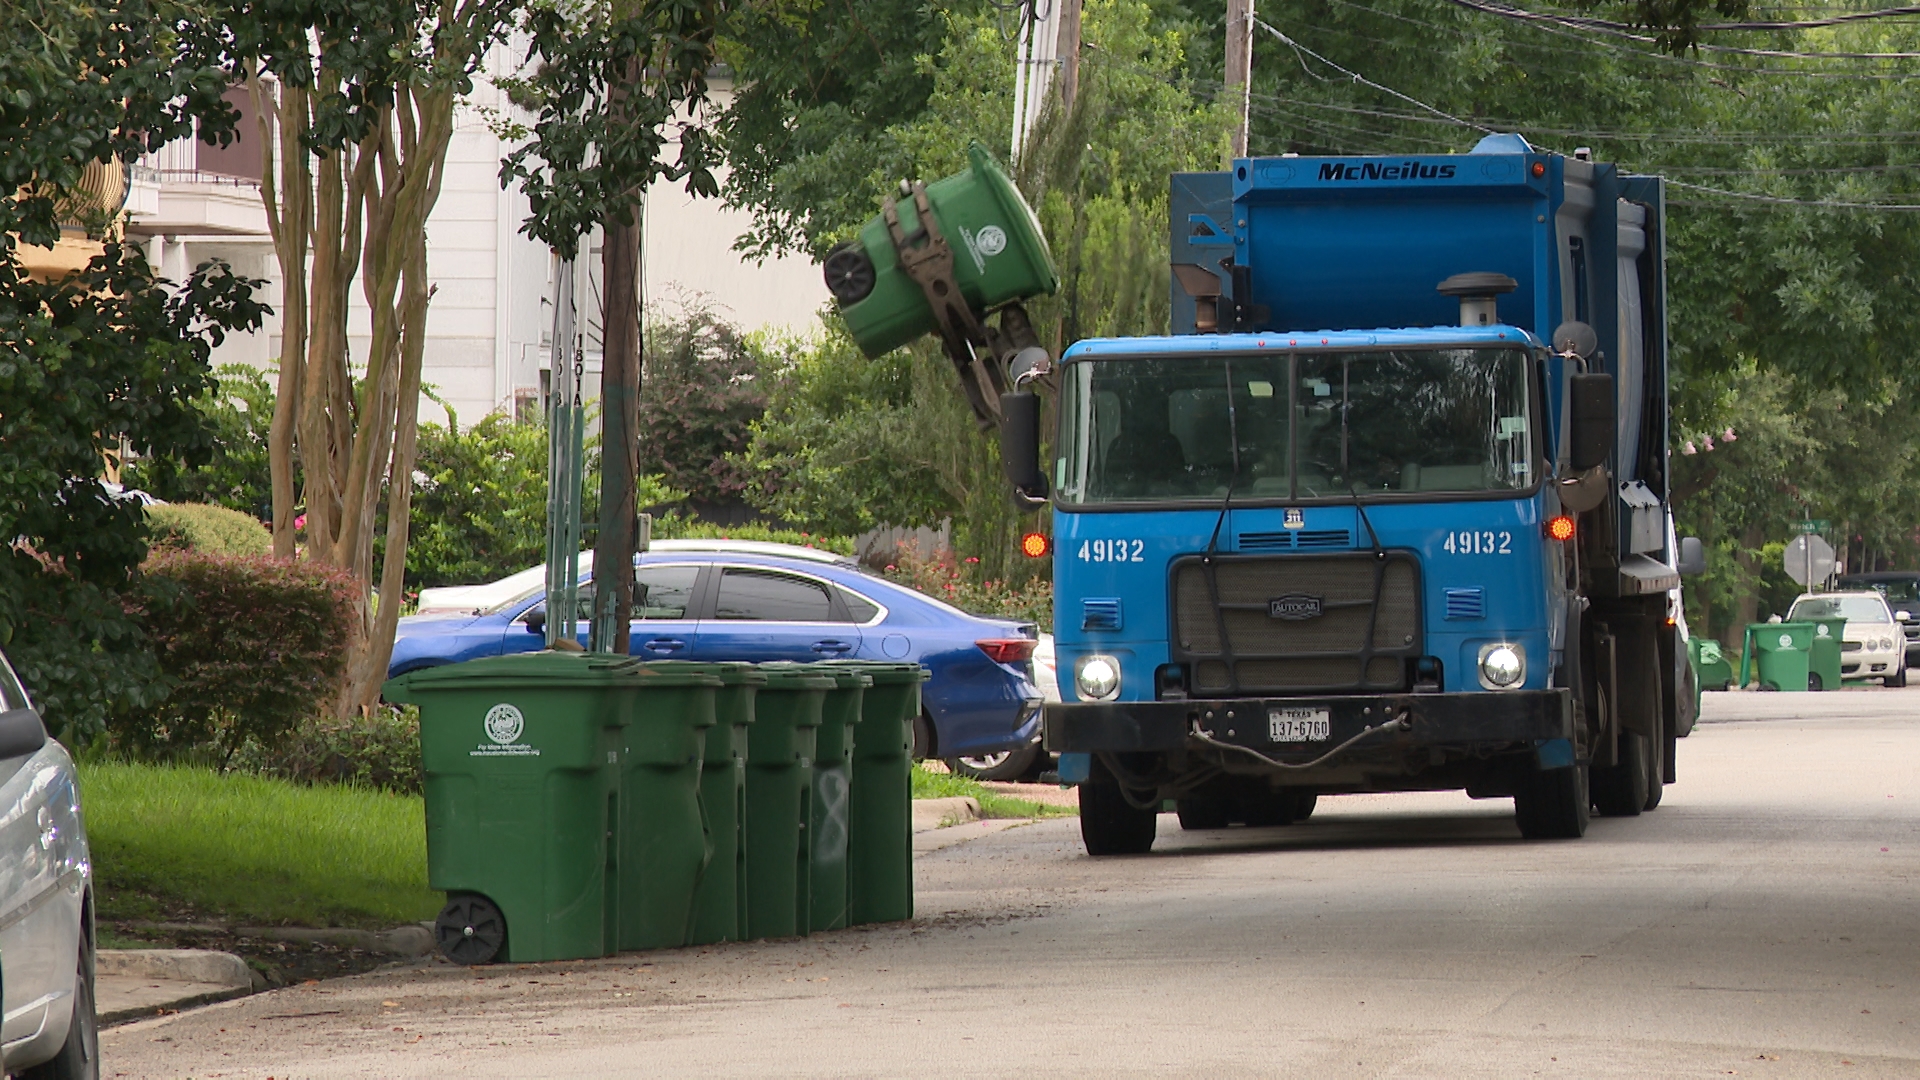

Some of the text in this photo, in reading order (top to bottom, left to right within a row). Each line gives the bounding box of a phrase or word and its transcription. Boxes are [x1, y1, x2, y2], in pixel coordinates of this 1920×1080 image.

[1318, 162, 1457, 181] McNeilus
[574, 333, 584, 406] 1801A
[1078, 539, 1144, 562] 49132
[1443, 531, 1512, 554] 49132
[1275, 602, 1317, 612] AUTOCAR
[1286, 710, 1312, 718] TEXAS
